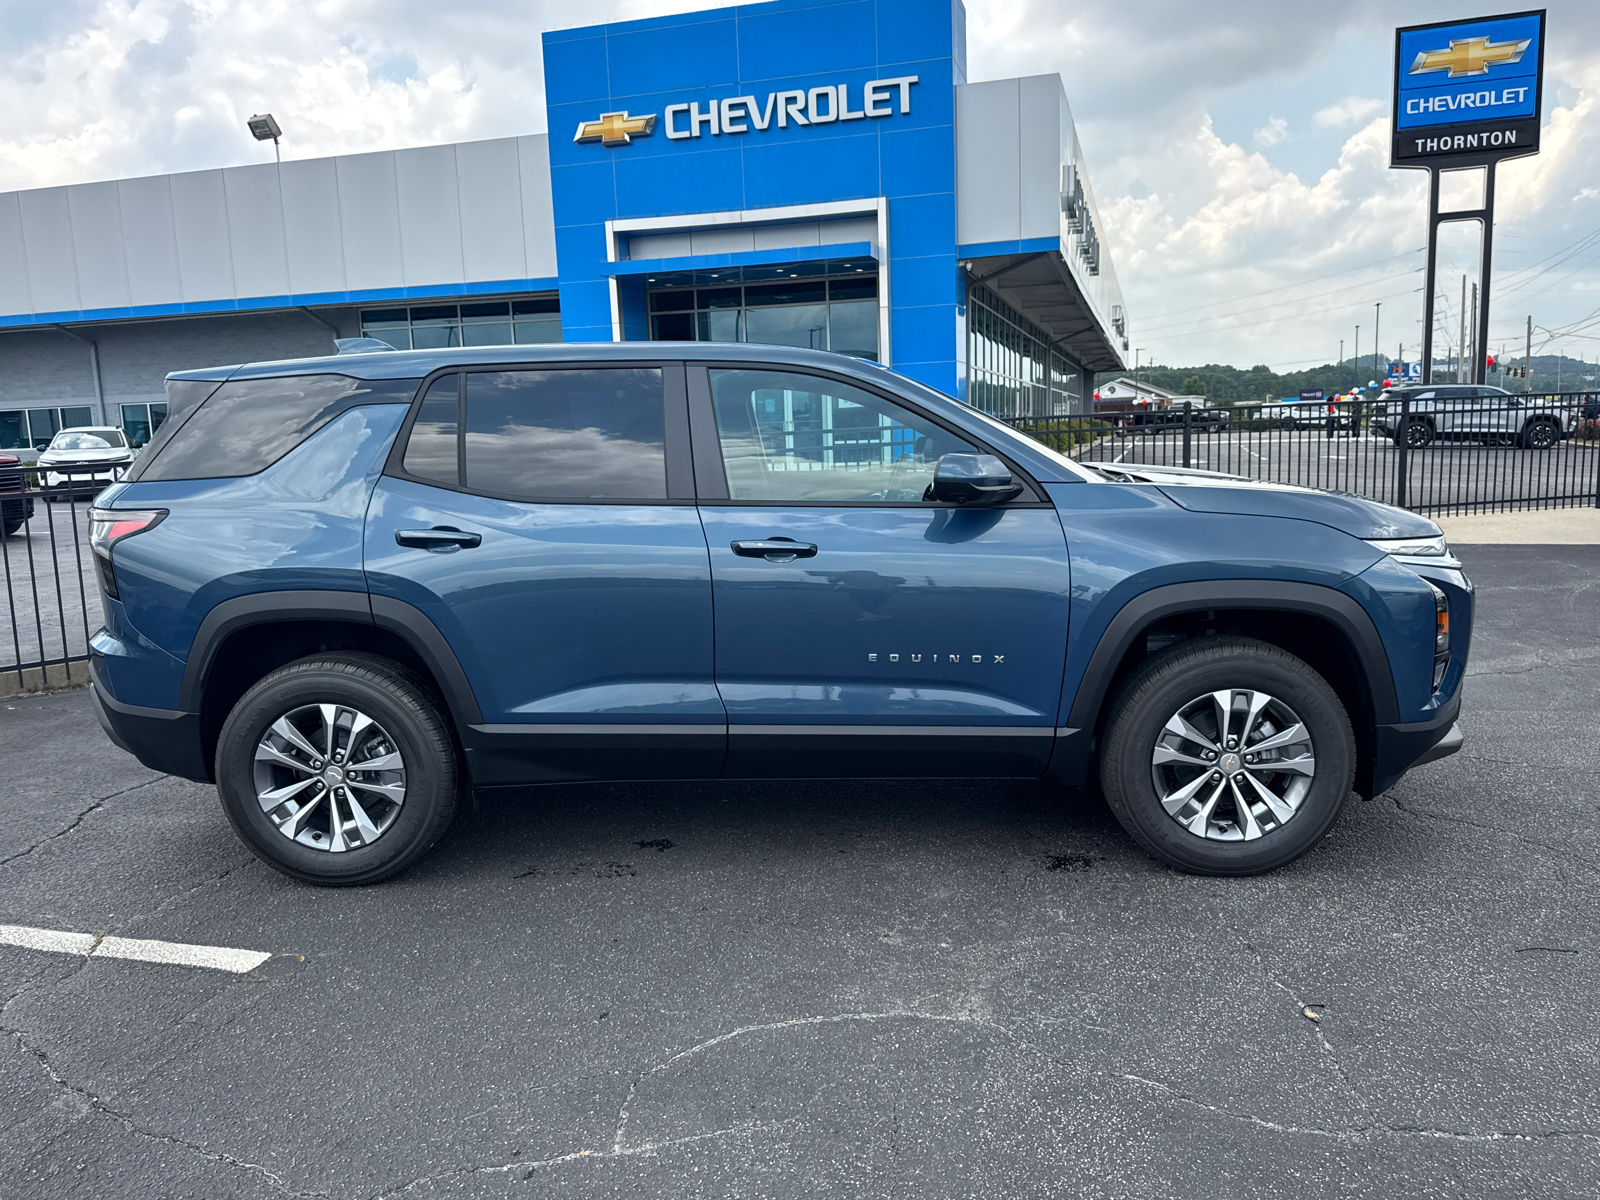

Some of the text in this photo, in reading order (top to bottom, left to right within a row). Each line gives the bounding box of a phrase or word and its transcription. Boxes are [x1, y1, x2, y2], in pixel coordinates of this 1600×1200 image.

[664, 75, 919, 139] CHEVROLET
[1406, 87, 1529, 114] CHEVROLET
[1415, 130, 1517, 153] THORNTON
[868, 653, 1005, 664] EQUINOX
